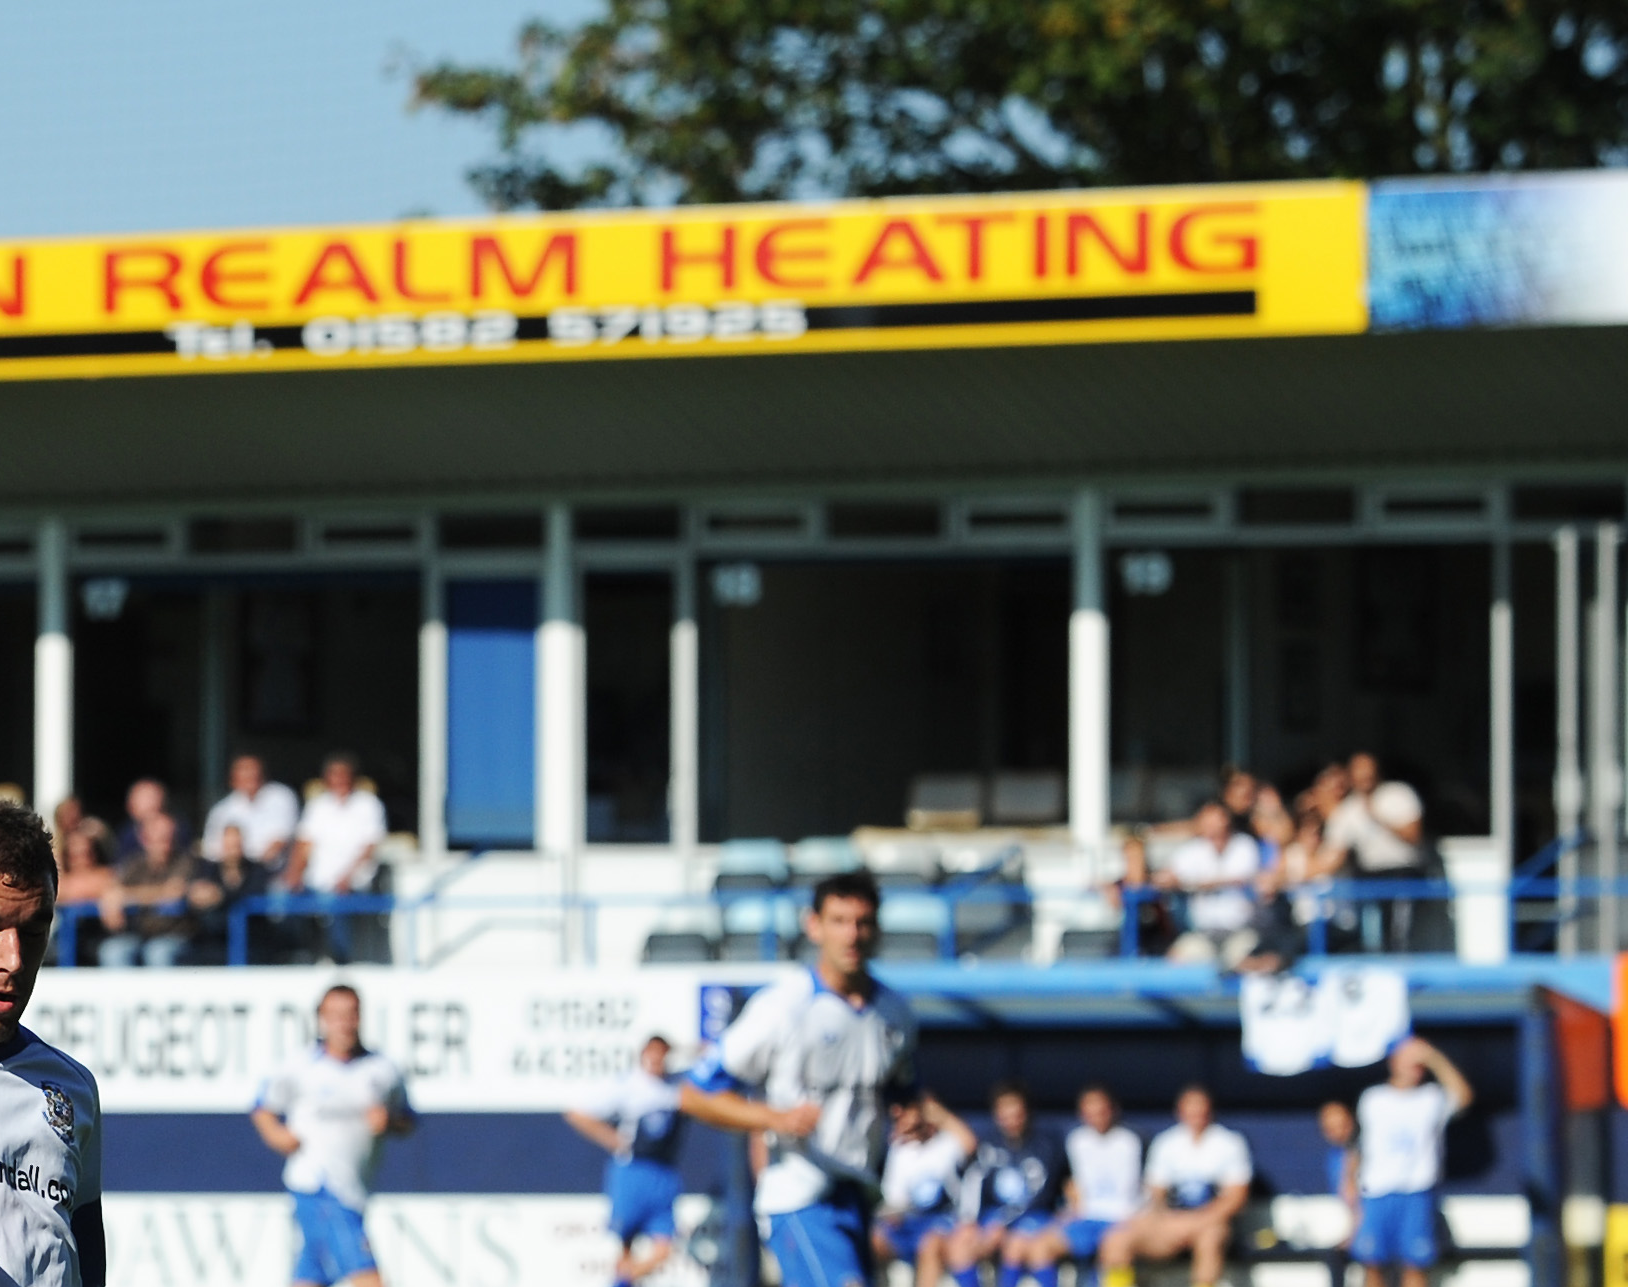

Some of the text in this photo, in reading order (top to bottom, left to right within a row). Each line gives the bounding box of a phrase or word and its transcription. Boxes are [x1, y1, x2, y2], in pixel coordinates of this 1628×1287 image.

[104, 232, 578, 314] REALM
[661, 203, 1261, 294] HEATING
[302, 310, 517, 357] 01582
[548, 300, 807, 343] 571925
